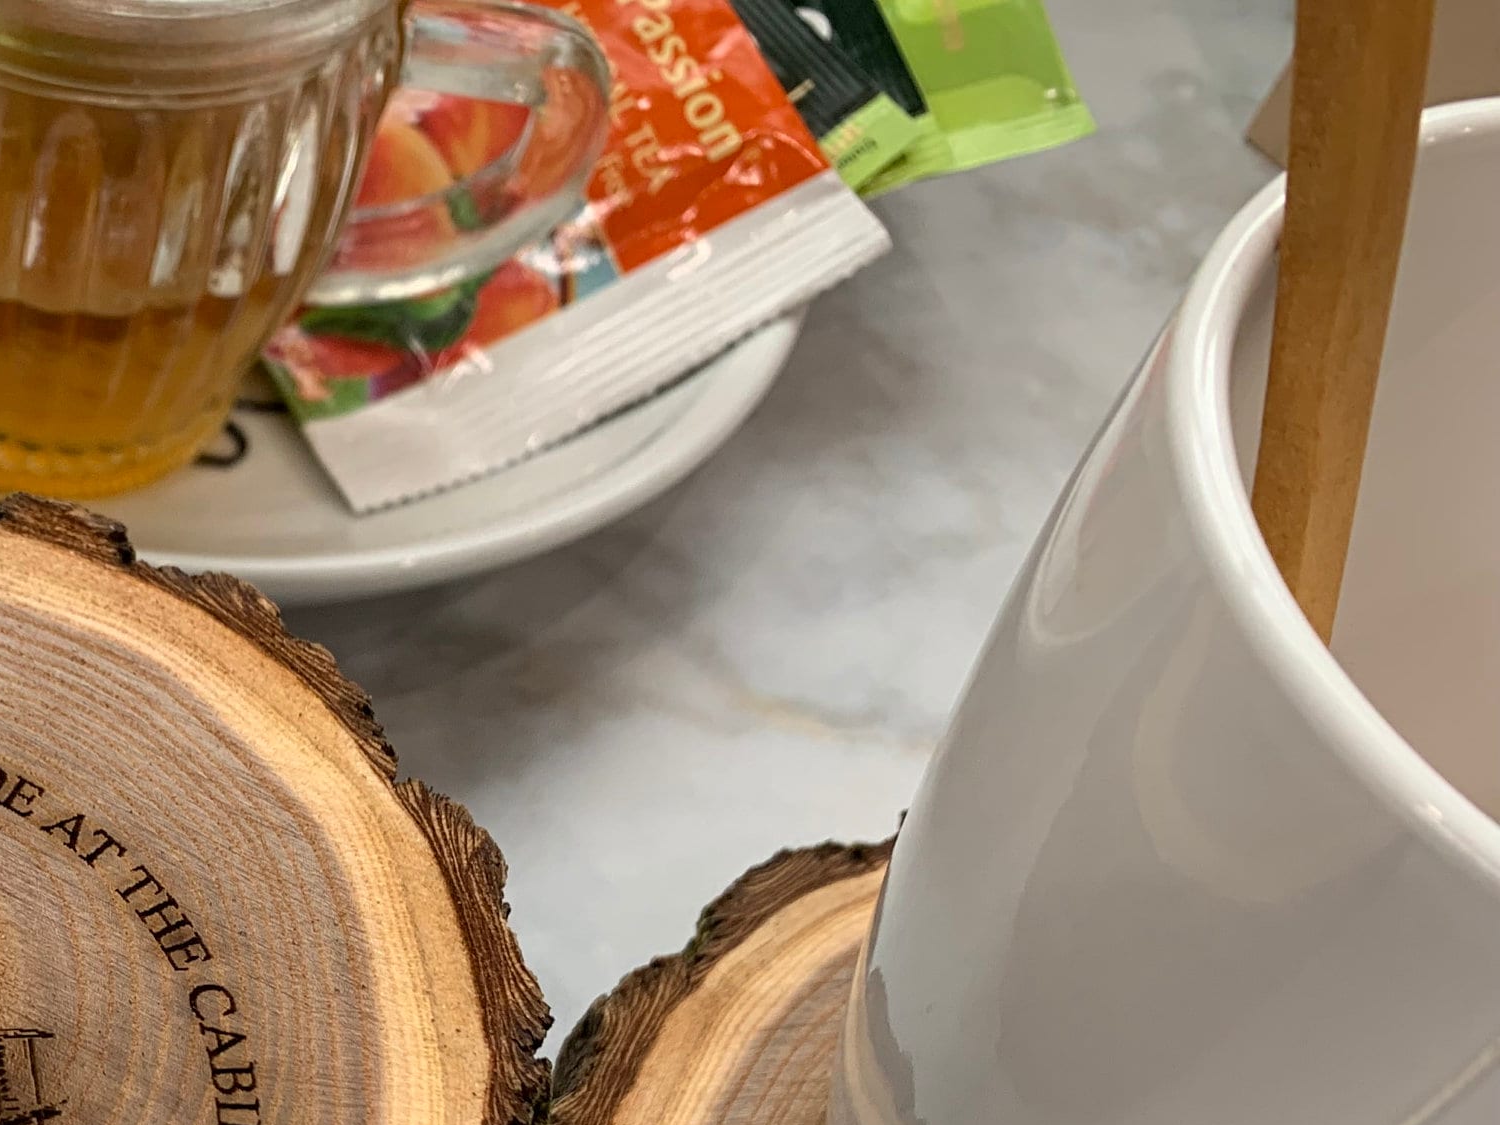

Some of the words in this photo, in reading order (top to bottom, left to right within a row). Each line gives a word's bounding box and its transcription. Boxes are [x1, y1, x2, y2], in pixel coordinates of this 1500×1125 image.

[615, 0, 743, 162] assion
[40, 813, 127, 868] AT
[114, 864, 211, 972] THE
